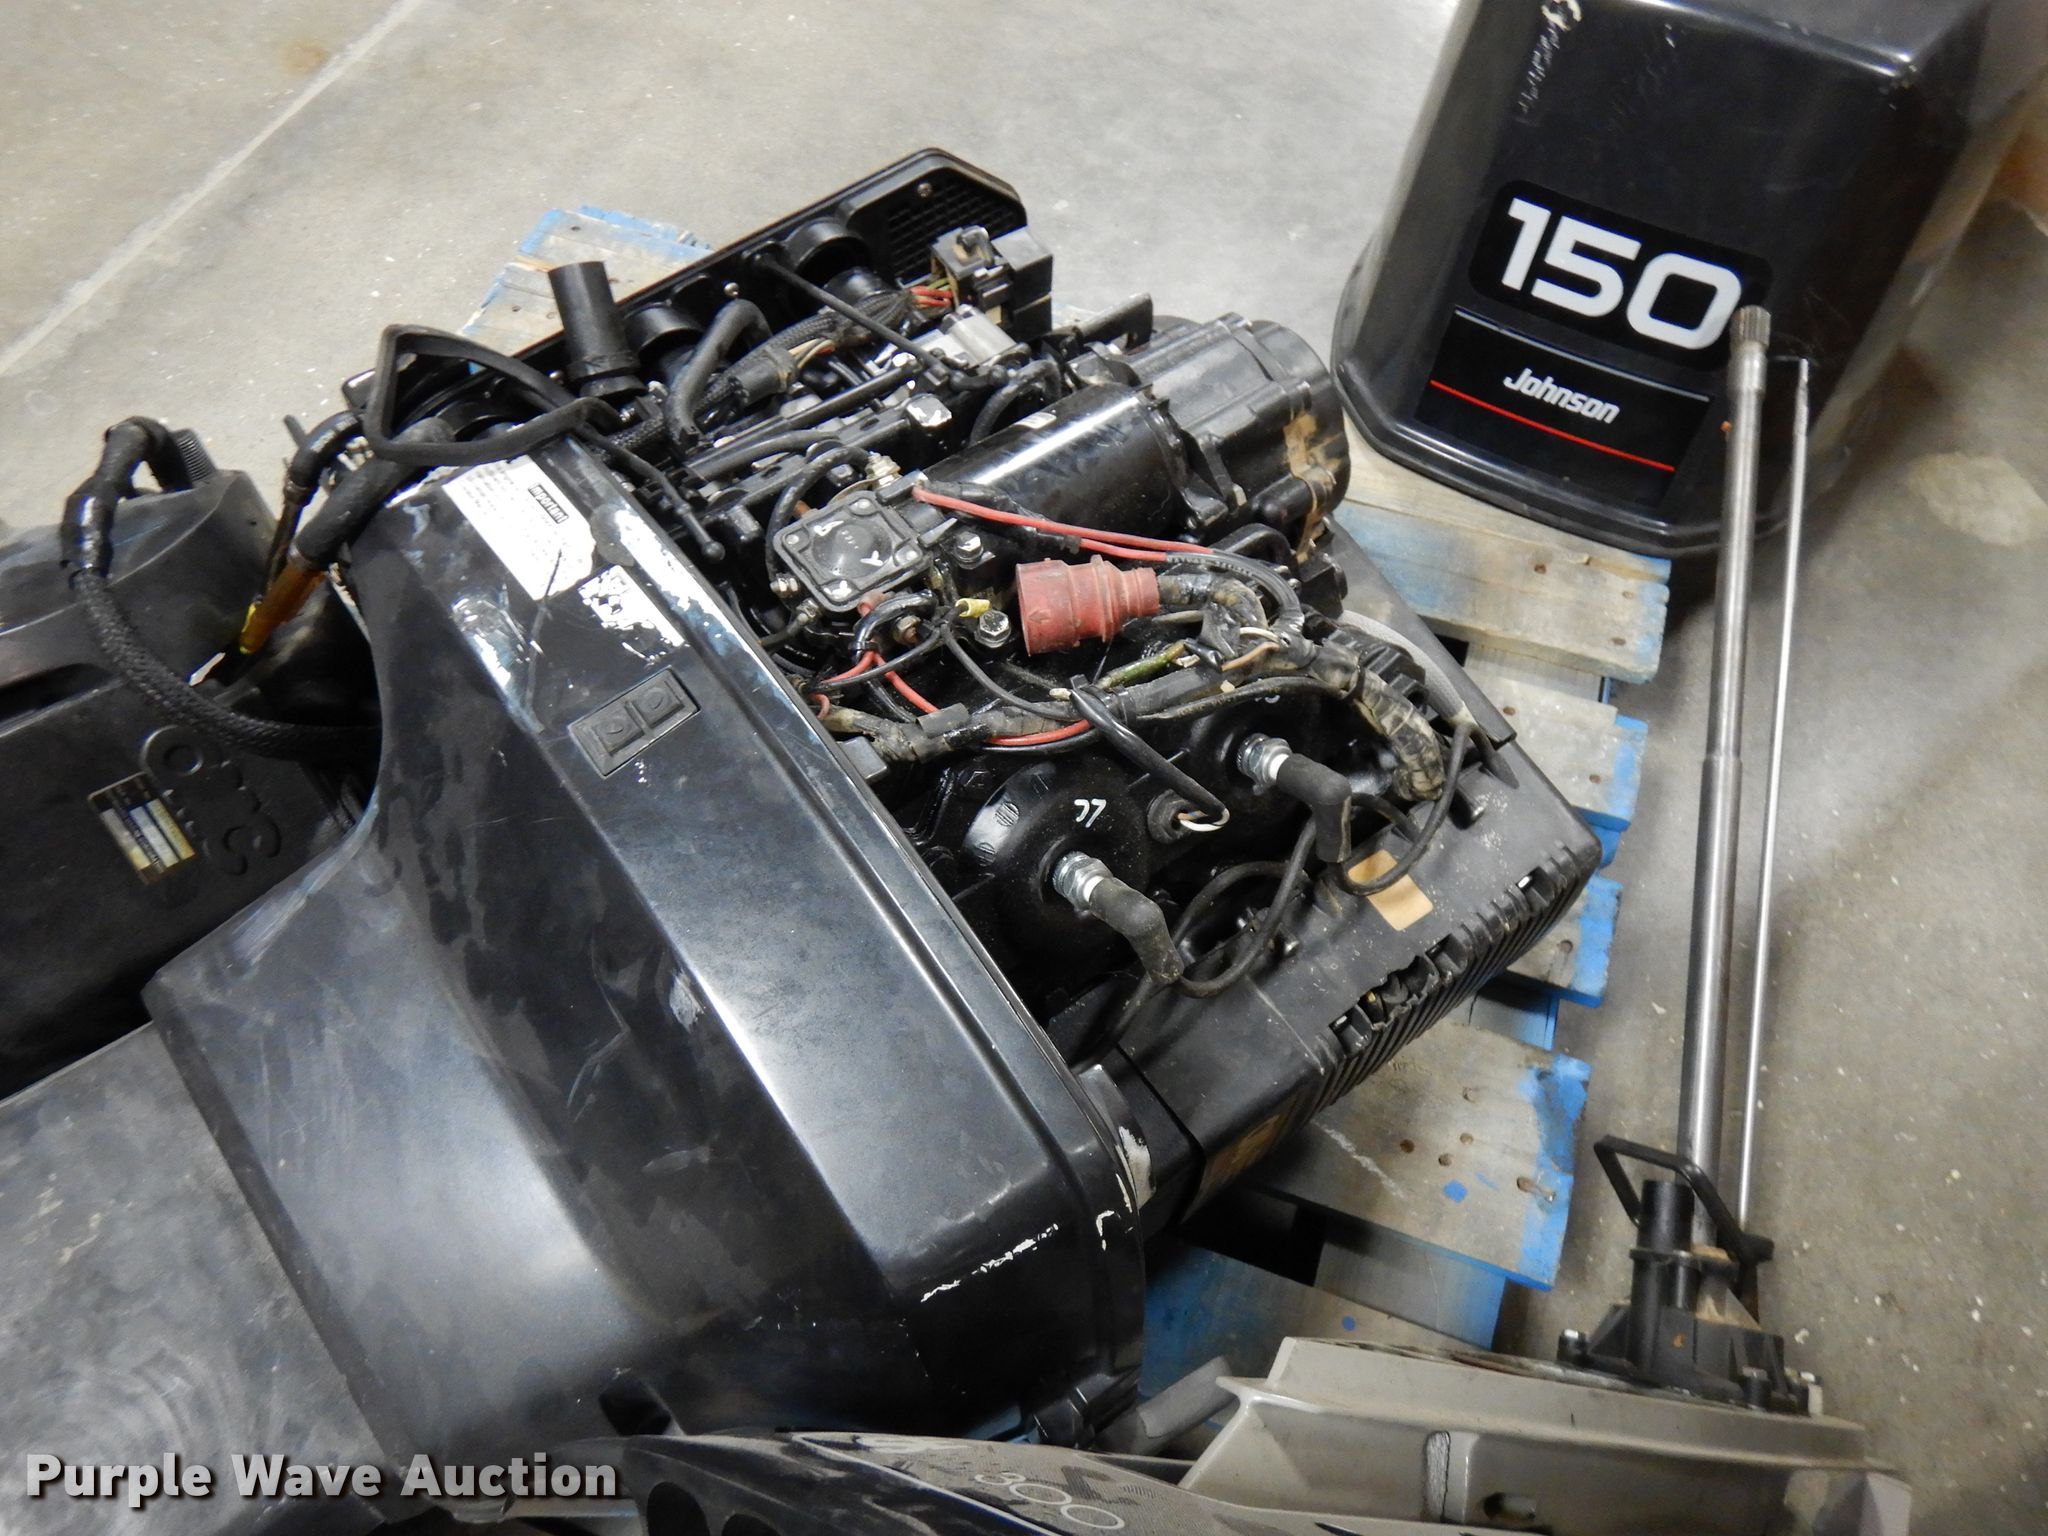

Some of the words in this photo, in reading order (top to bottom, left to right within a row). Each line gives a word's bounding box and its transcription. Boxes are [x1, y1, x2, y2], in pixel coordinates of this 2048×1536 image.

[1501, 197, 1742, 350] 150
[1503, 367, 1620, 425] Johnson
[974, 1471, 1126, 1530] 300
